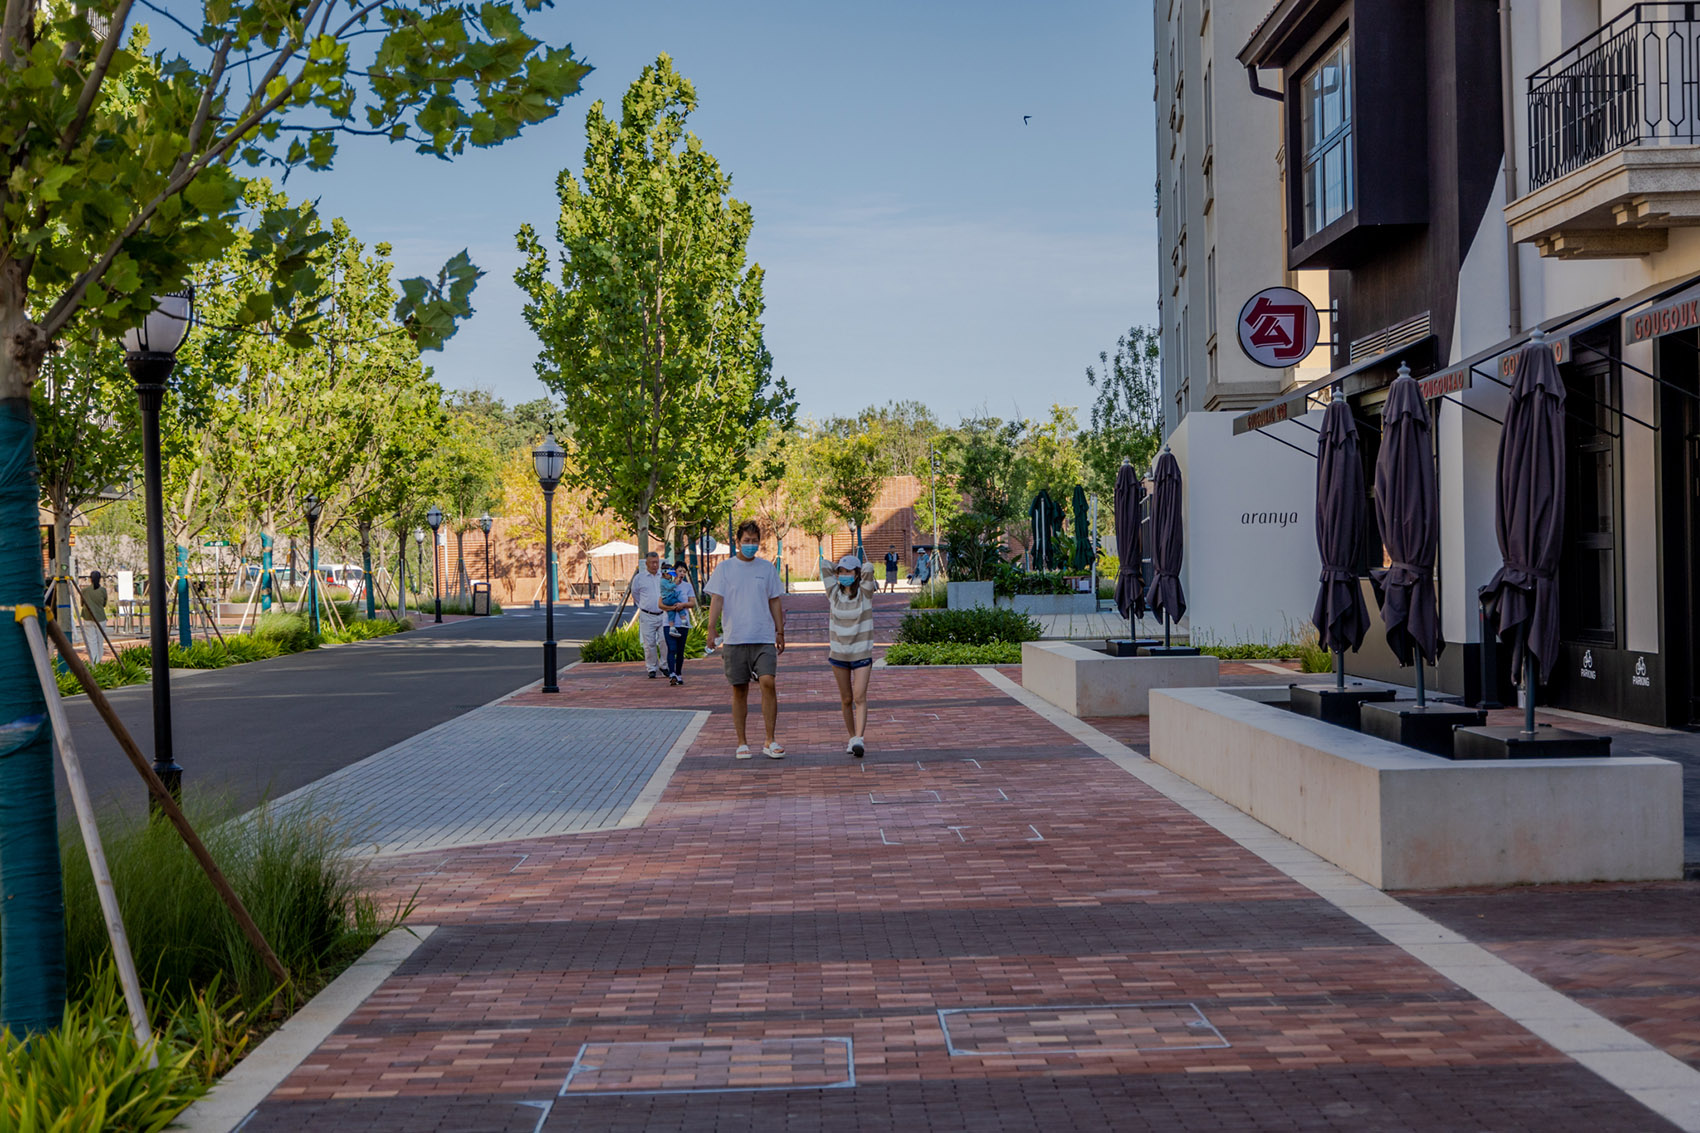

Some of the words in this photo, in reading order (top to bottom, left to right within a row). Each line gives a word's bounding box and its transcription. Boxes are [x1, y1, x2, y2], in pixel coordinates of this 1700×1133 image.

[1634, 300, 1700, 340] GOUGOUK
[1241, 511, 1298, 529] aranya
[1580, 668, 1597, 680] PARKING
[1632, 675, 1650, 687] PARKING
